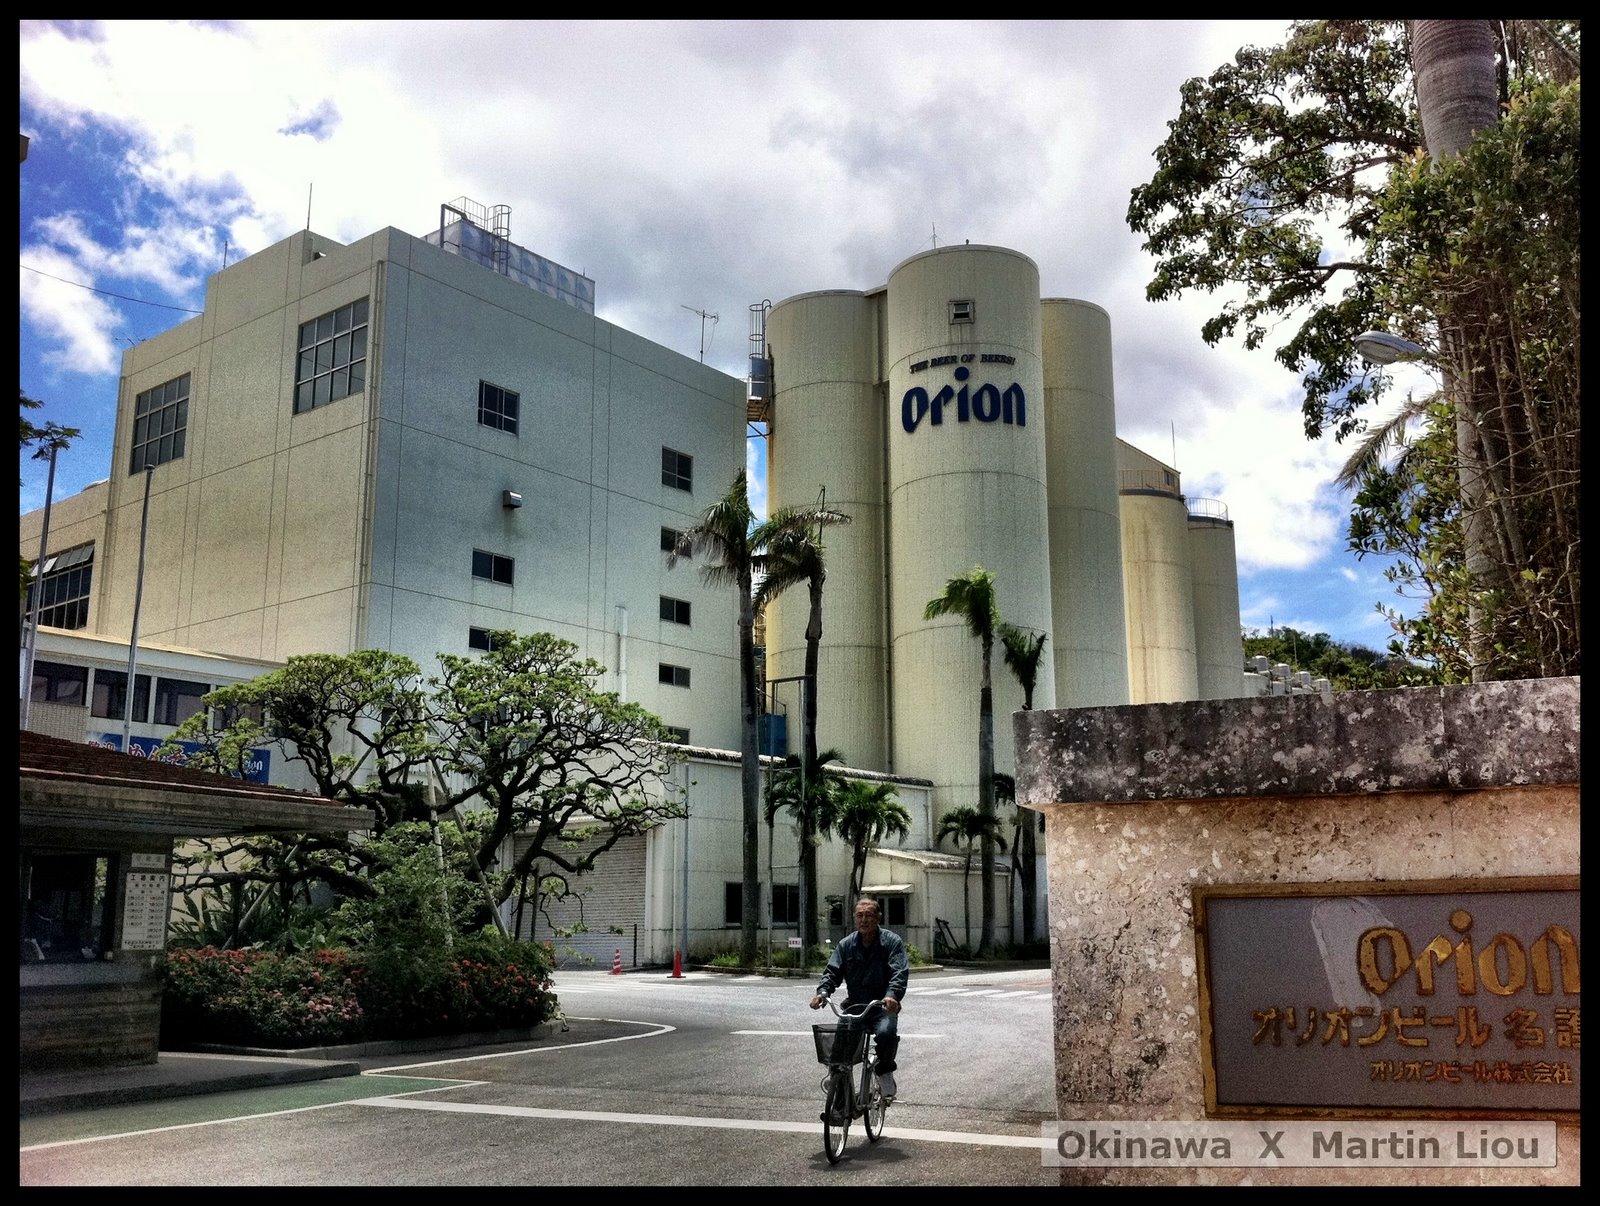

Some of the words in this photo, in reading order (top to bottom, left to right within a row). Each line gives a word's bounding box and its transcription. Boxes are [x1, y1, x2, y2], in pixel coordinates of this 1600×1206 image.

[930, 354, 959, 368] BEER
[960, 353, 976, 363] OF
[1370, 1060, 1574, 1085] オリオンビール株式会社
